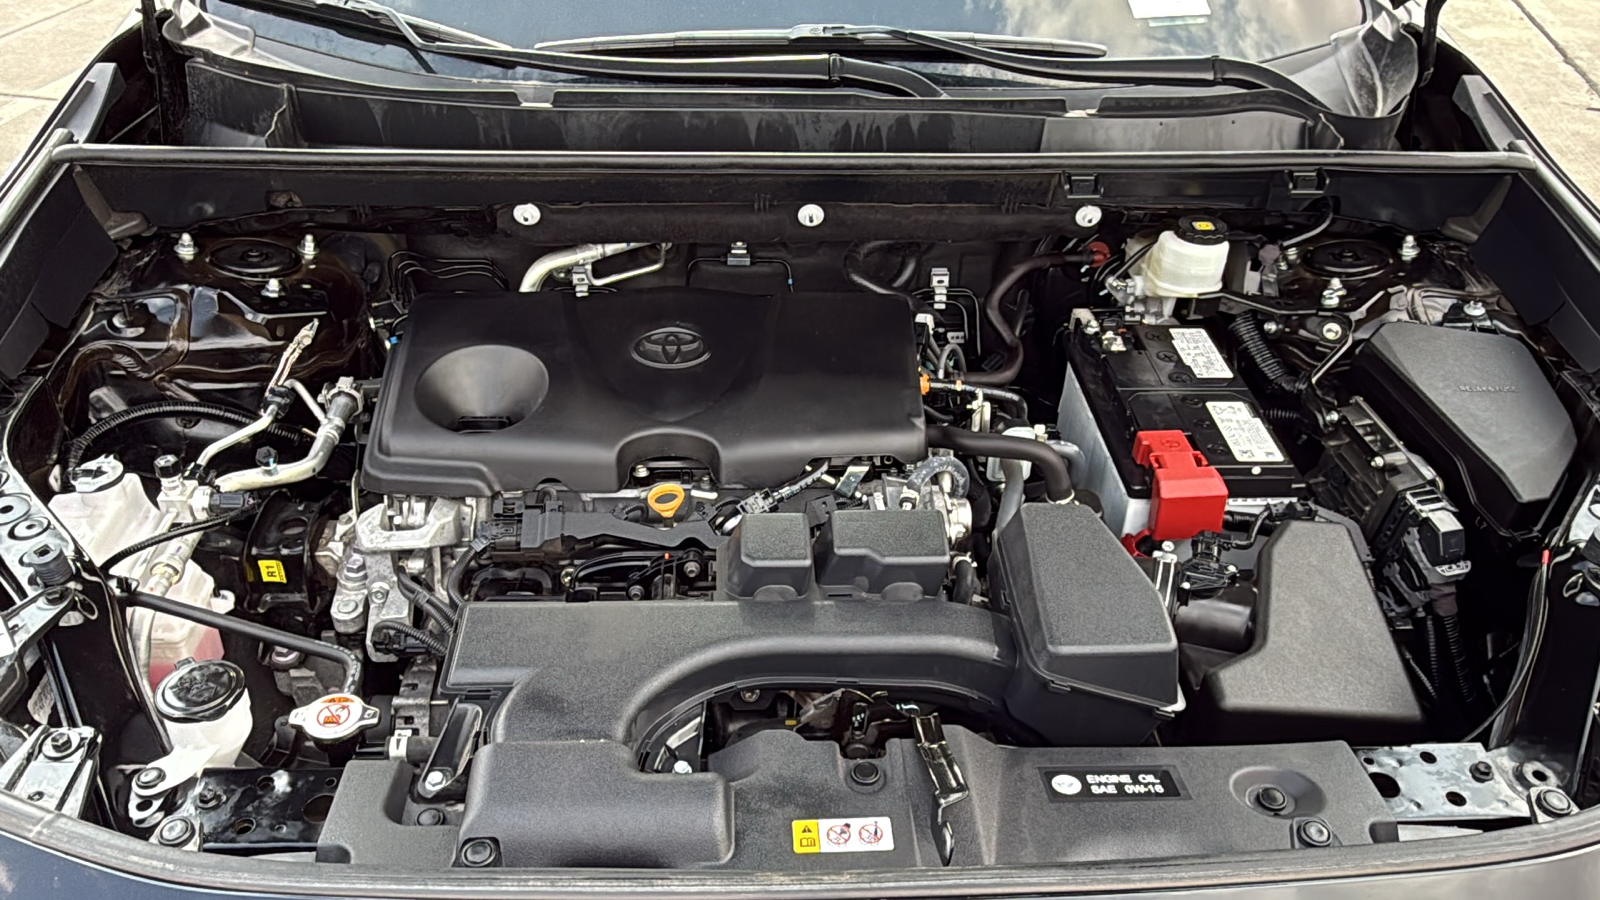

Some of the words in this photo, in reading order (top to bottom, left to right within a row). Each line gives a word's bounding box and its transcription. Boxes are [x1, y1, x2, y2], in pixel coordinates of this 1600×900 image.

[265, 566, 277, 577] R1
[1086, 774, 1132, 783] ENGINE
[1138, 774, 1160, 783] OIL
[1091, 785, 1118, 793] SAE
